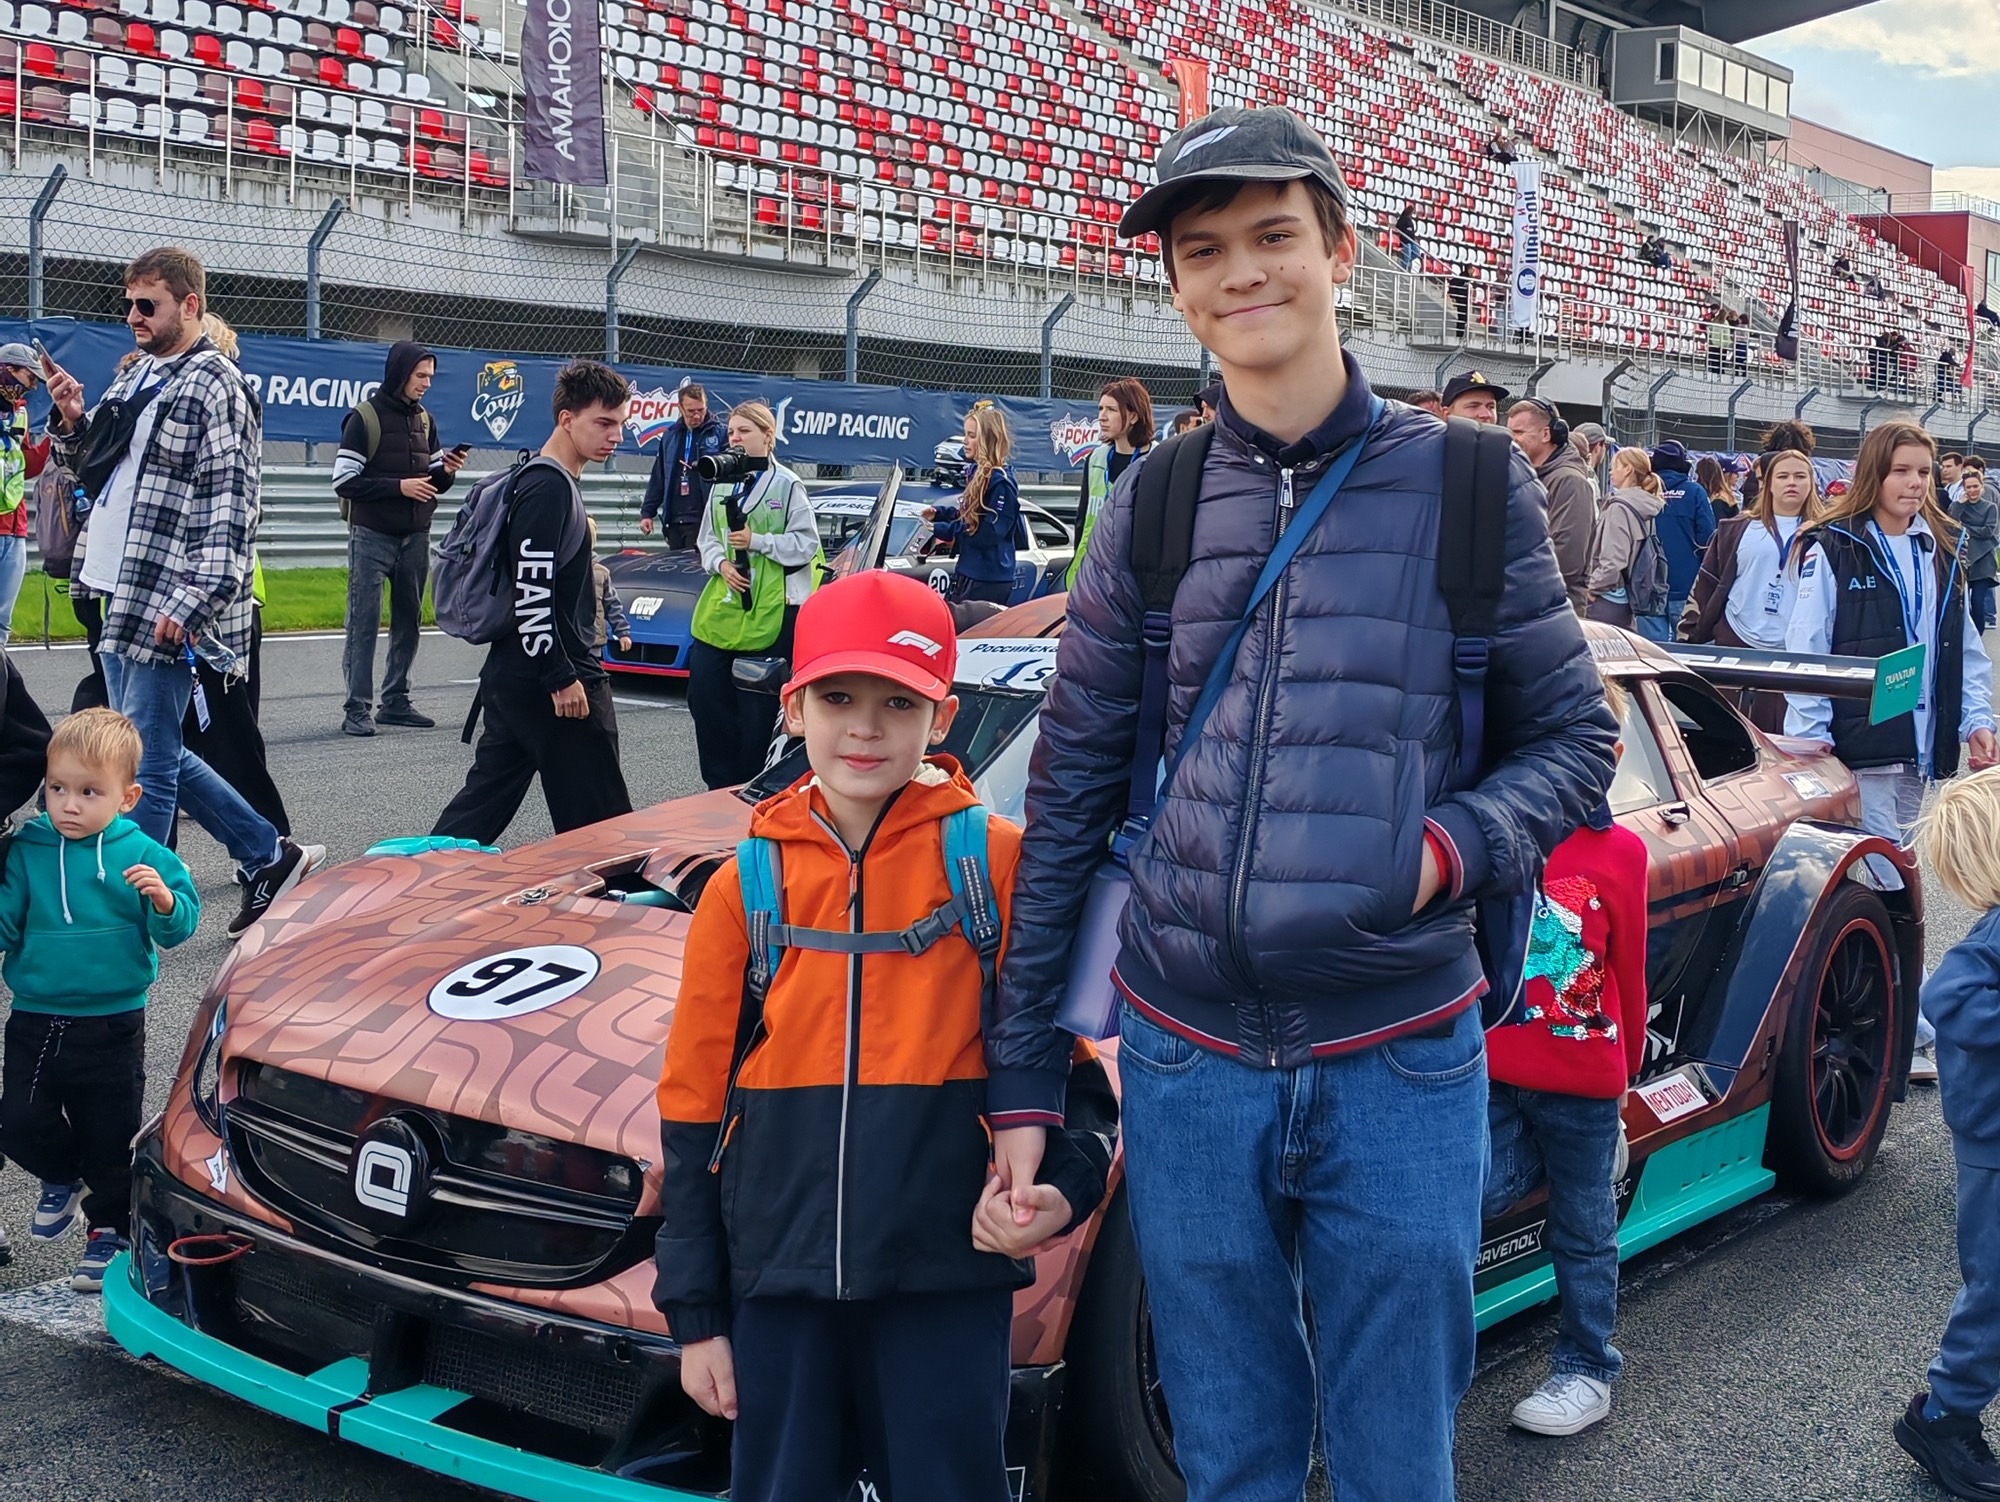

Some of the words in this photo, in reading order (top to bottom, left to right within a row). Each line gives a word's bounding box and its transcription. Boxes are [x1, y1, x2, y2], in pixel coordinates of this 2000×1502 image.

[546, 0, 576, 162] OKOHAMA
[790, 410, 837, 435] SMP
[838, 413, 910, 440] RACING
[514, 538, 555, 658] JEANS
[445, 957, 588, 1006] 97
